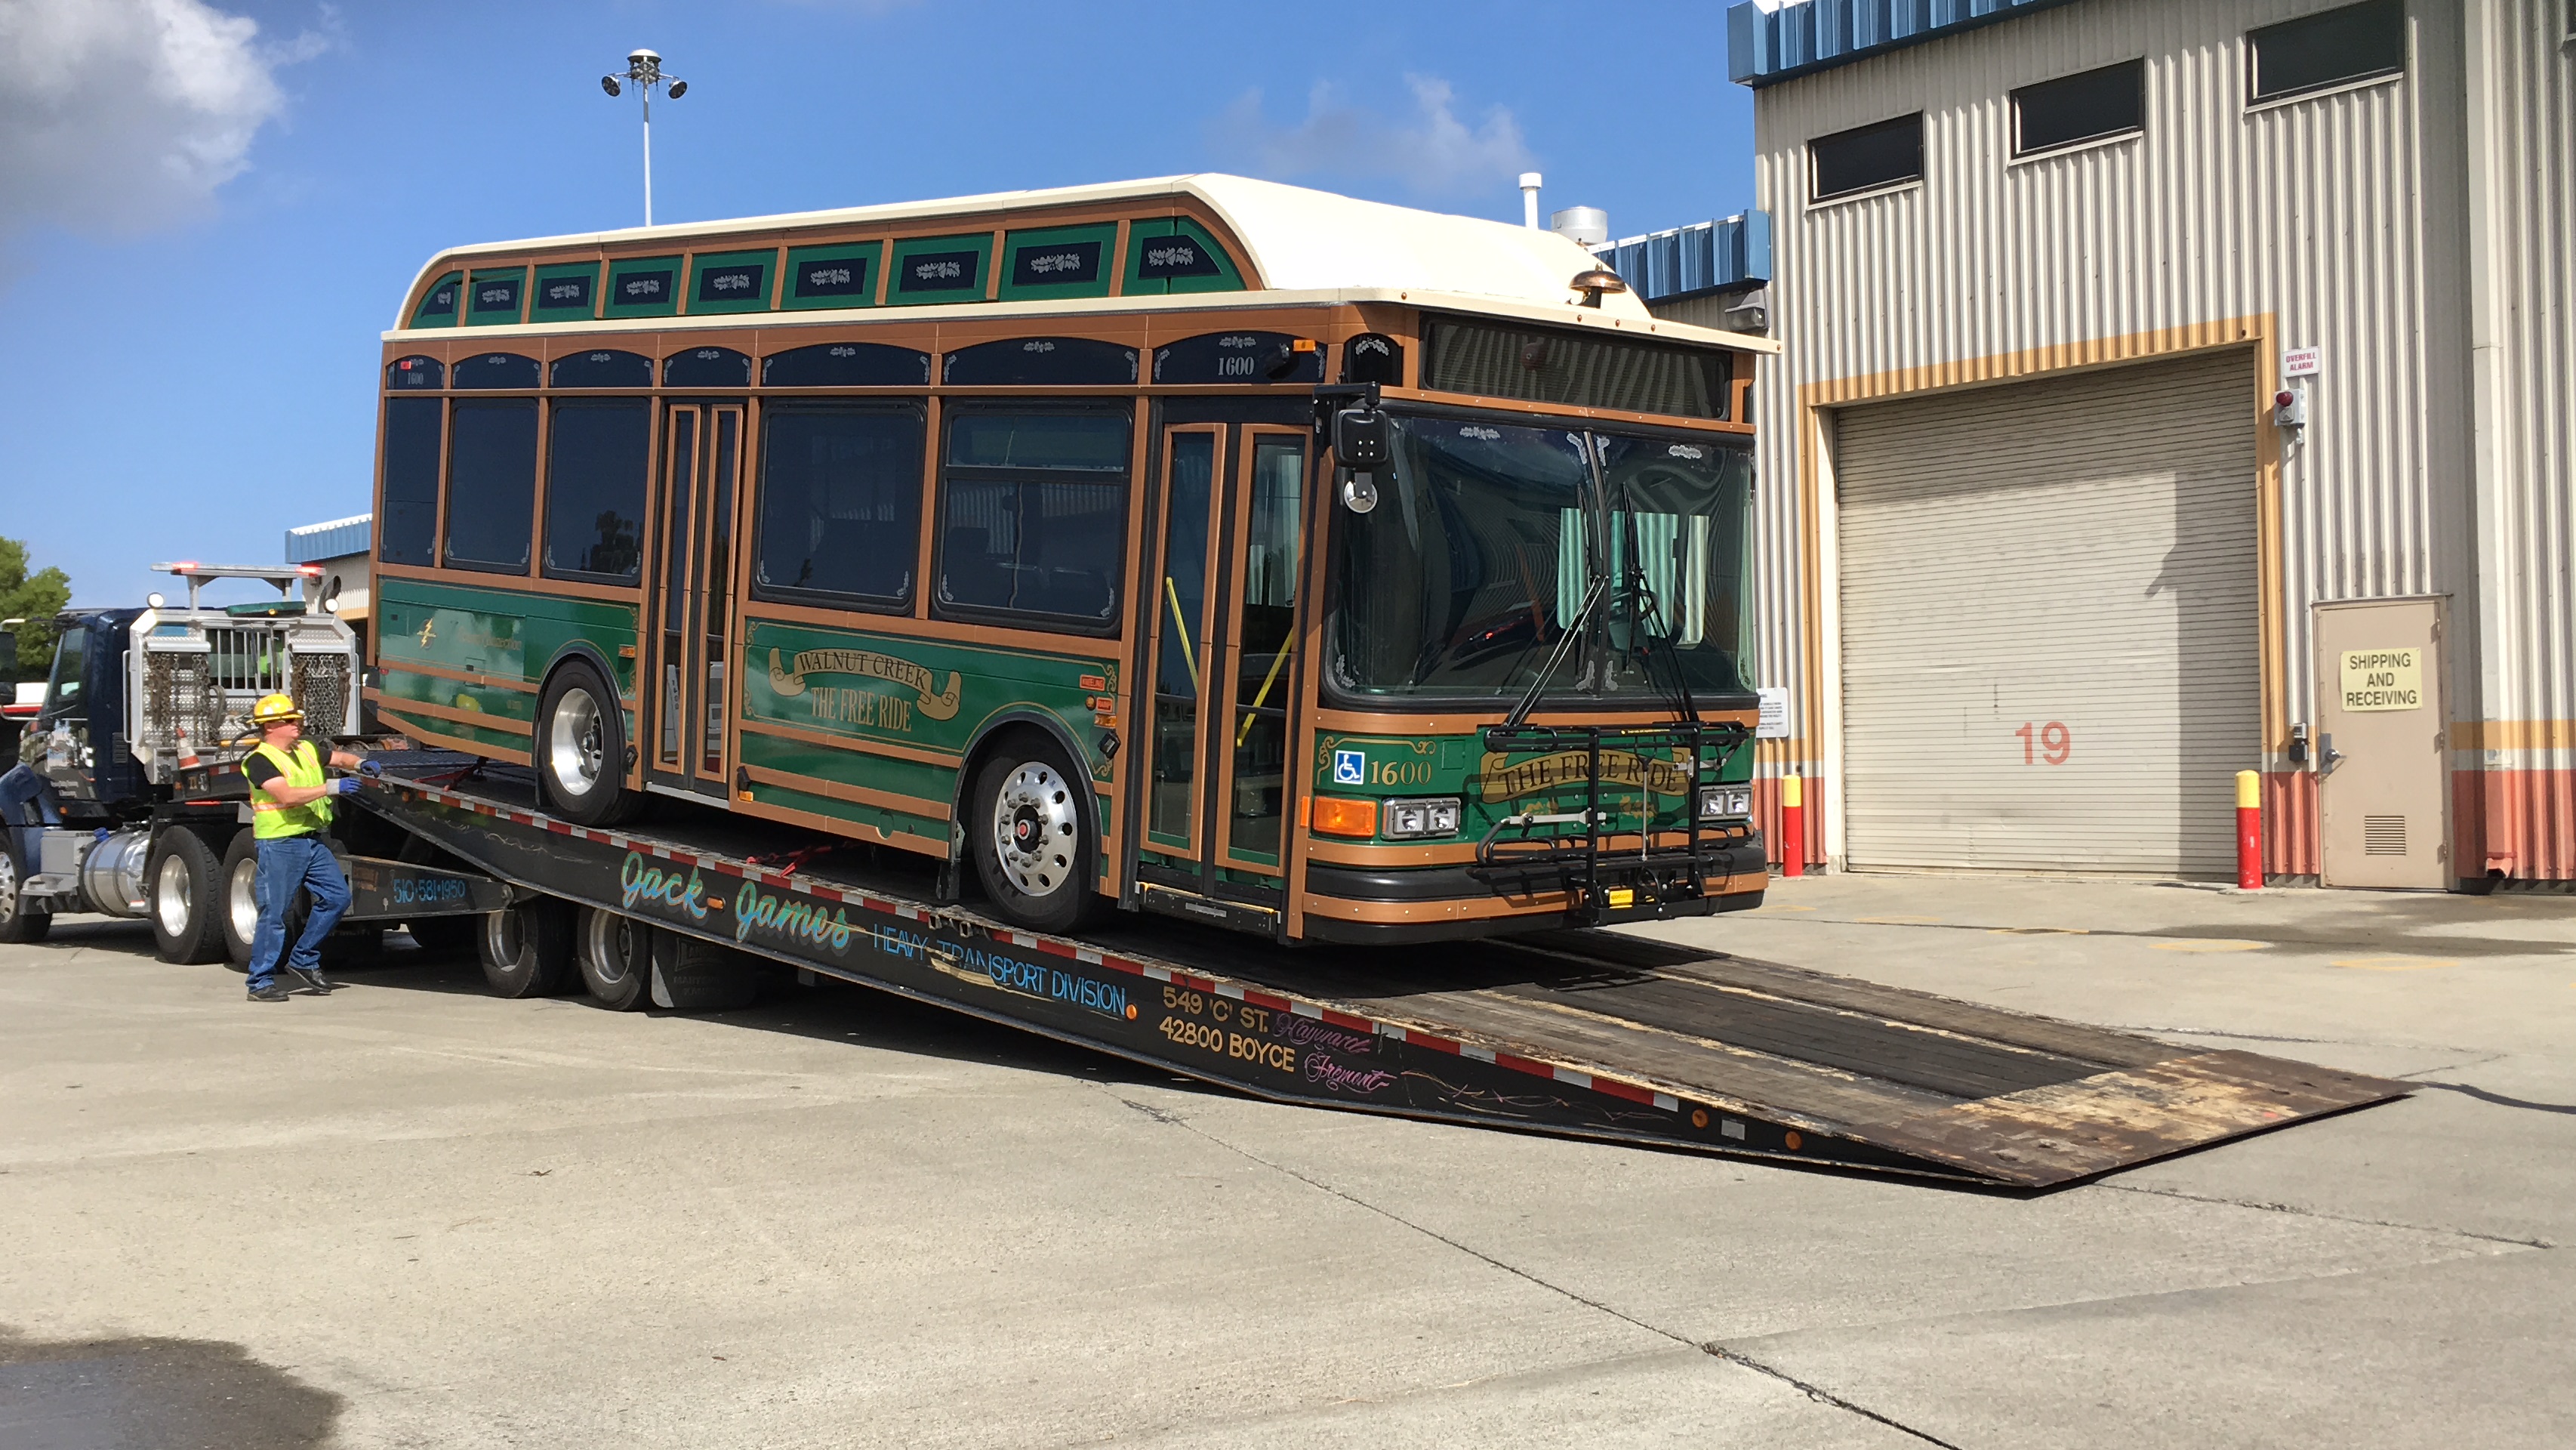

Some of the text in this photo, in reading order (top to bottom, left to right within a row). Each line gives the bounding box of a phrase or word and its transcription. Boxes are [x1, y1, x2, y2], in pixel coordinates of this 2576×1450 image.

[1218, 356, 1255, 376] 1600
[2285, 352, 2316, 363] OVERFILL
[2290, 361, 2313, 372] ALARM
[799, 652, 927, 690] WALNUT CREEK
[2350, 652, 2411, 670] SHIPPING
[2367, 672, 2395, 687] AND
[811, 687, 913, 733] THE FREE RIDE
[2346, 690, 2417, 707] RECEIVING
[2015, 720, 2071, 765] 19
[1370, 760, 1431, 785] 1600
[1498, 758, 1554, 796] THE
[1625, 757, 1678, 791] RDE
[621, 850, 852, 949] Jack James
[874, 924, 1126, 1016] HEAVY TRANSPORT DIVISION
[1163, 986, 1203, 1015] 549
[1240, 1007, 1269, 1033] ST.
[1272, 1013, 1373, 1054] Hayward
[1159, 1016, 1397, 1093] 42800 BOYCE Fremont
